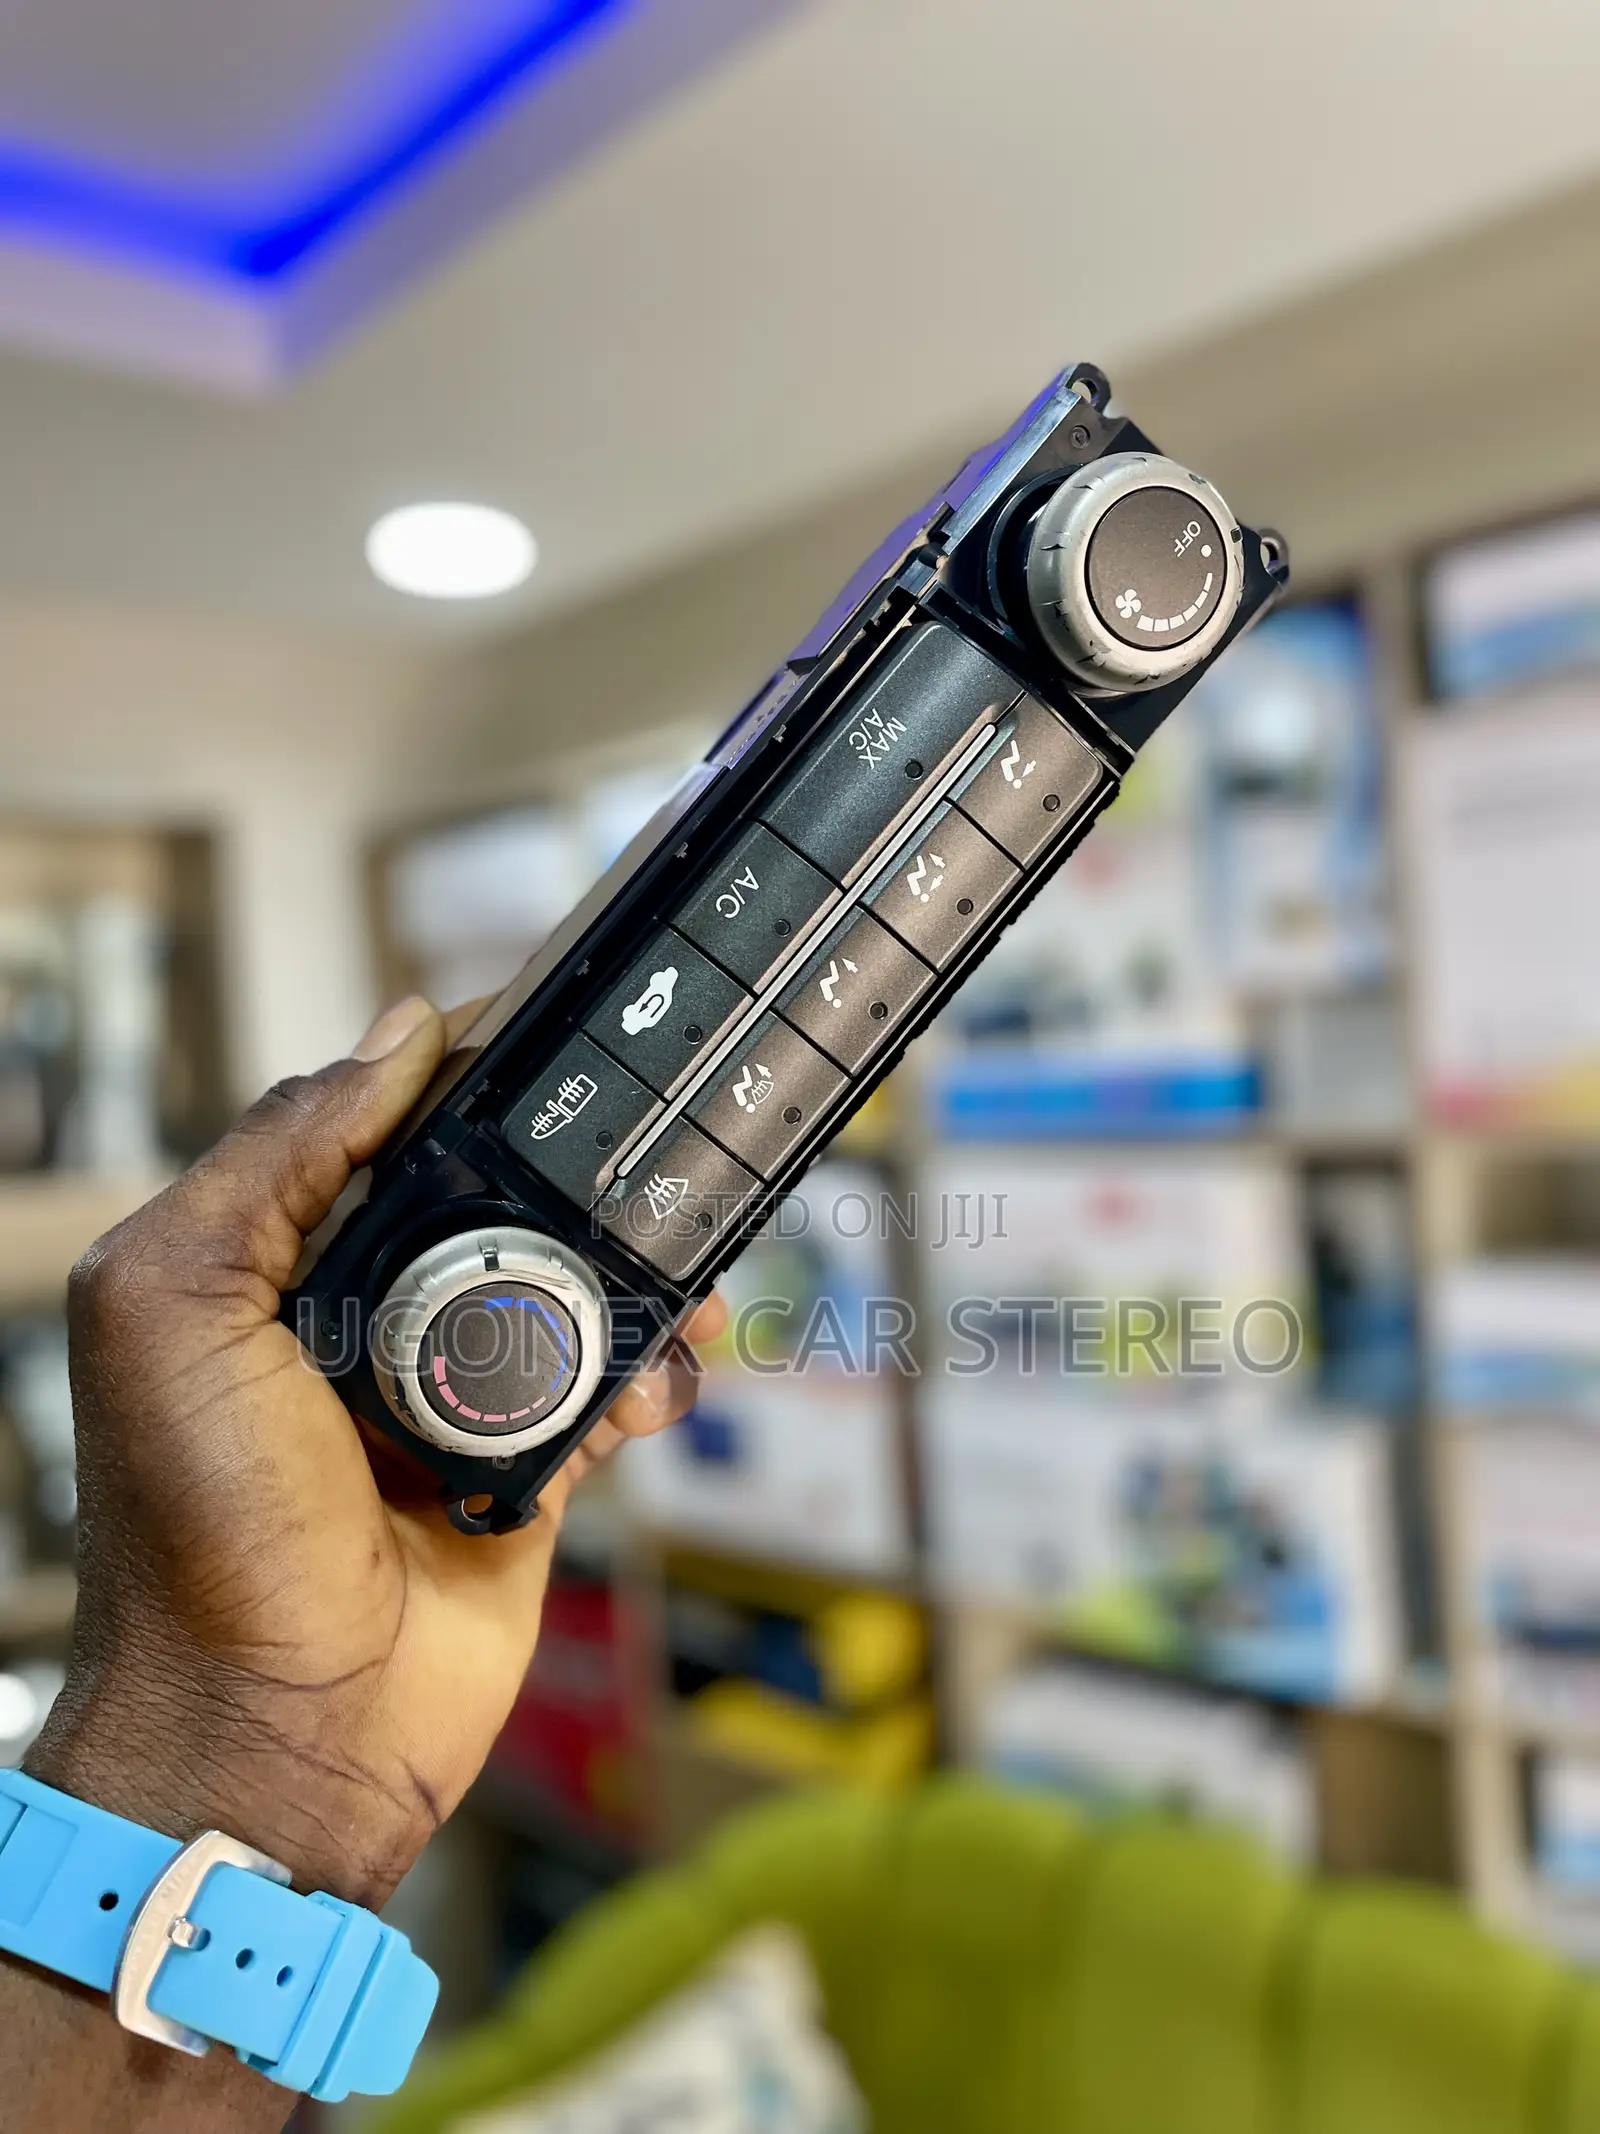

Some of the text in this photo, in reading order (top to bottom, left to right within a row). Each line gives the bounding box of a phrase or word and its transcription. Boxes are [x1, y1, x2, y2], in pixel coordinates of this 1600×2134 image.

[1173, 520, 1201, 557] OFF
[849, 708, 885, 752] A/C
[858, 717, 907, 770] MAX
[715, 866, 761, 920] A/C
